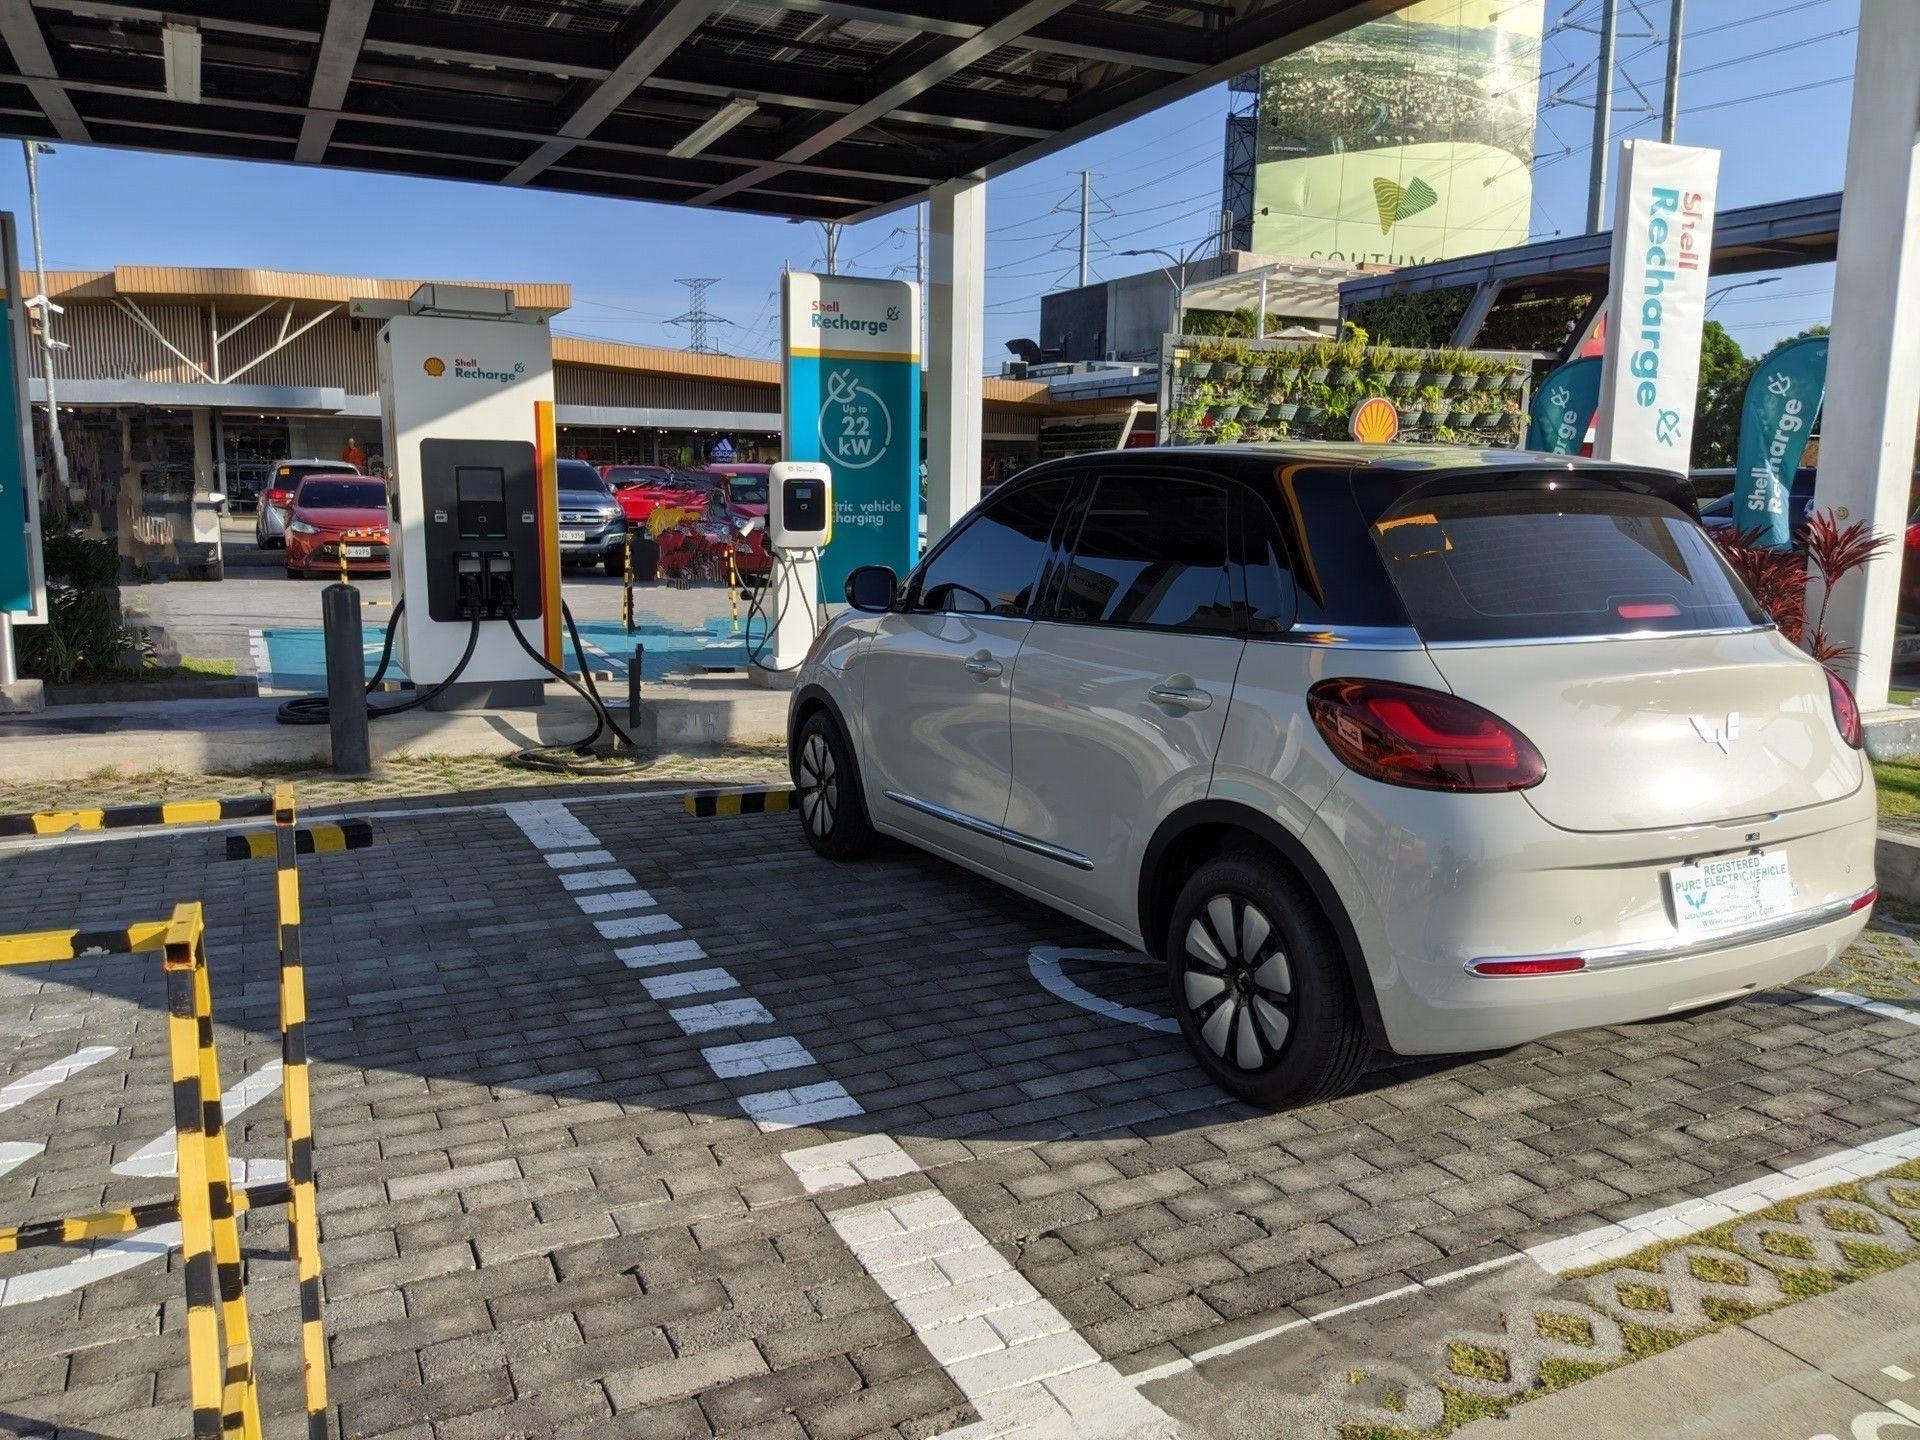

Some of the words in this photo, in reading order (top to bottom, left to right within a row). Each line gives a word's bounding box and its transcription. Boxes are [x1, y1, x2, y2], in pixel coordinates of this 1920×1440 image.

[811, 300, 840, 312] Shell
[1631, 187, 1680, 408] Recharge
[811, 313, 888, 336] Recharge
[455, 359, 477, 367] Shell
[455, 368, 516, 383] Recharge
[842, 404, 856, 415] Up
[858, 405, 868, 413] to
[841, 416, 870, 436] 22
[838, 437, 872, 455] kW
[1748, 467, 1769, 512] Shell
[860, 500, 901, 512] vehicle
[1703, 857, 1760, 876] REGISTERED
[1675, 879, 1702, 893] PURE
[1704, 870, 1749, 888] ELECTRIC
